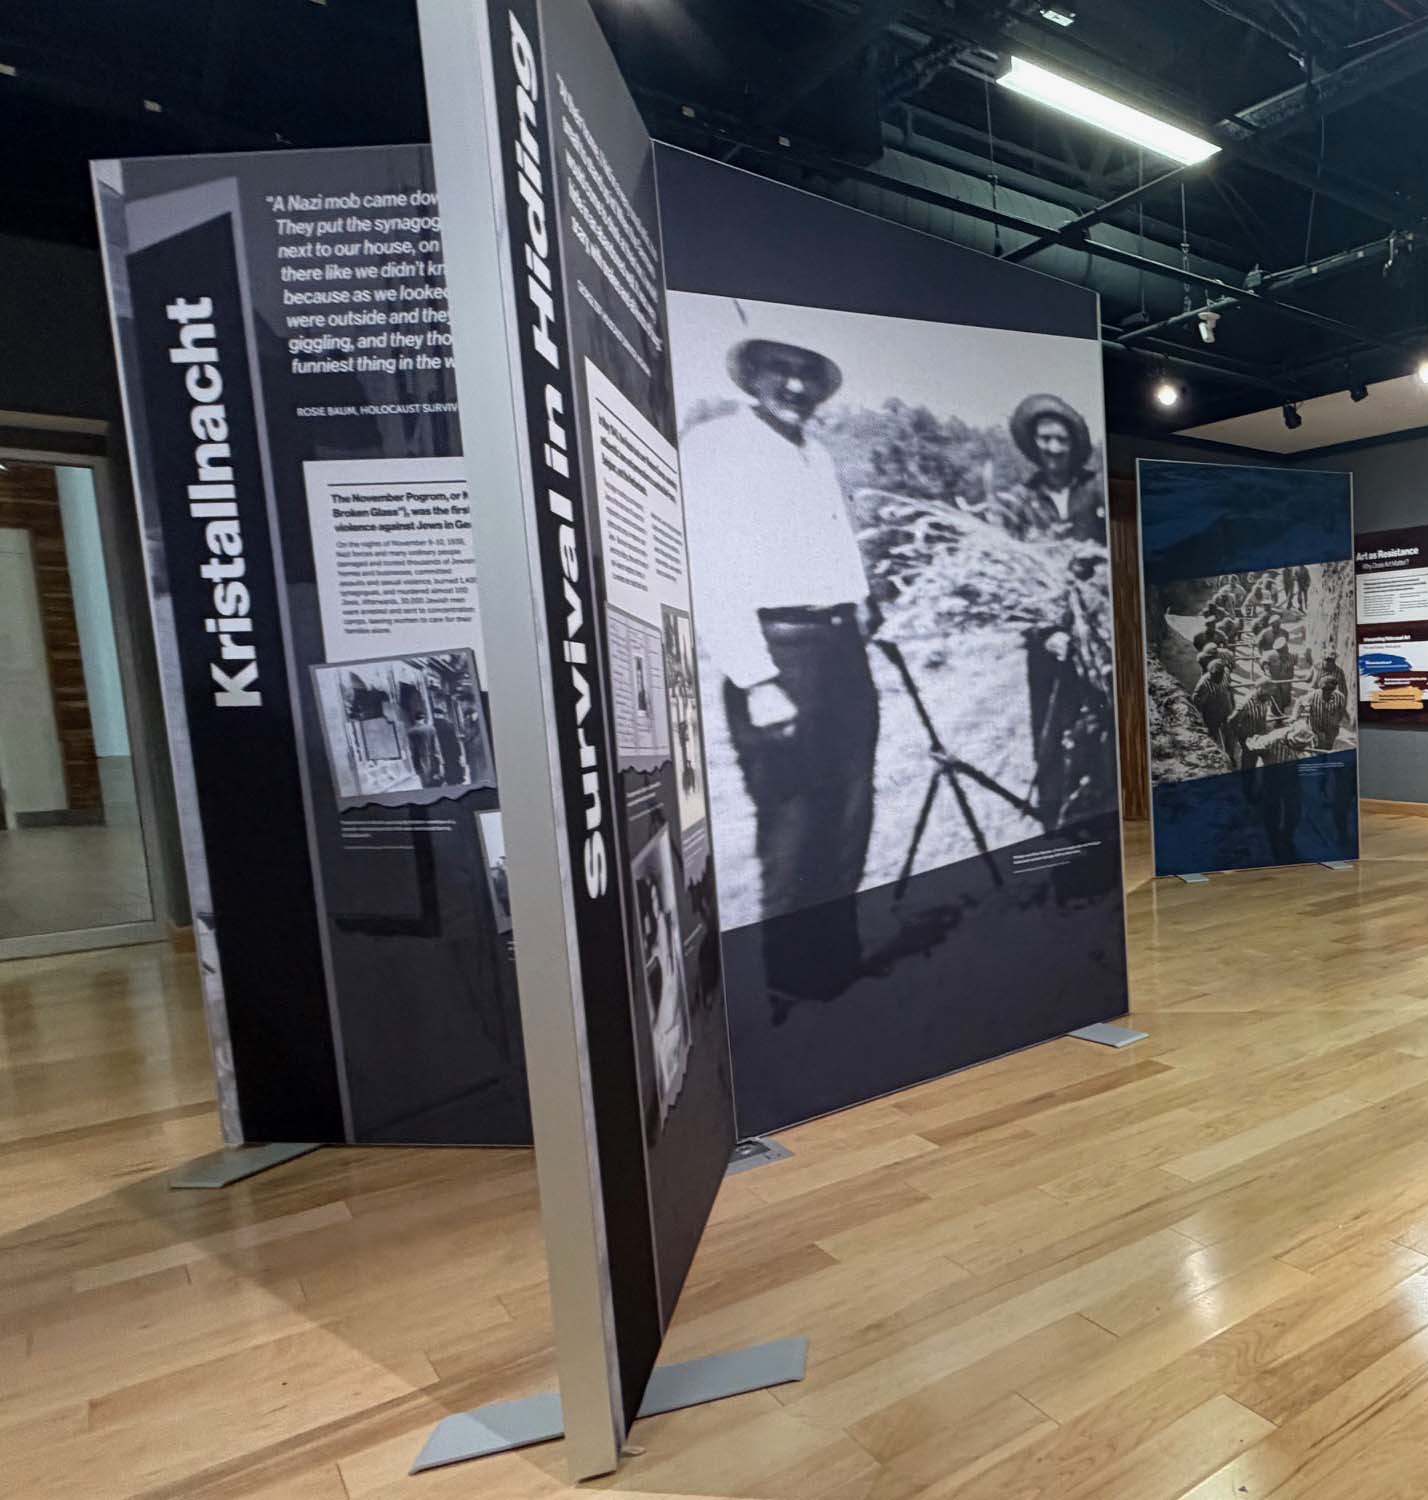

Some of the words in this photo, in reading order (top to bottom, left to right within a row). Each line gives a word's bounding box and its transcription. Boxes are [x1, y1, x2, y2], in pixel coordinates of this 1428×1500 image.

[508, 8, 559, 370] Hiding
[287, 193, 322, 211] Nazi
[324, 191, 360, 209] mob
[363, 194, 407, 208] came
[276, 218, 314, 237] They
[317, 217, 343, 237] put
[346, 215, 372, 232] the
[278, 241, 312, 258] next
[315, 241, 332, 257] to
[334, 243, 361, 256] our
[363, 239, 416, 256] house,
[418, 240, 439, 253] on
[280, 265, 322, 282] there
[325, 263, 352, 281] like
[354, 265, 378, 279] we
[283, 289, 350, 305] because
[352, 289, 372, 302] as
[374, 288, 397, 301] we
[286, 314, 326, 328] were
[328, 309, 387, 327] outside
[389, 308, 419, 324] and
[288, 334, 355, 354] giggling,
[357, 332, 387, 349] and
[390, 332, 423, 350] they
[291, 357, 354, 374] funniest
[356, 355, 397, 374] thing
[399, 354, 414, 370] in
[416, 354, 441, 370] the
[360, 403, 420, 415] HOLOCAUST
[544, 382, 569, 480] in
[166, 296, 263, 708] Kristallnacht
[331, 493, 351, 503] The
[352, 492, 404, 503] November
[1377, 547, 1419, 559] Resistance
[548, 487, 607, 900] Survival
